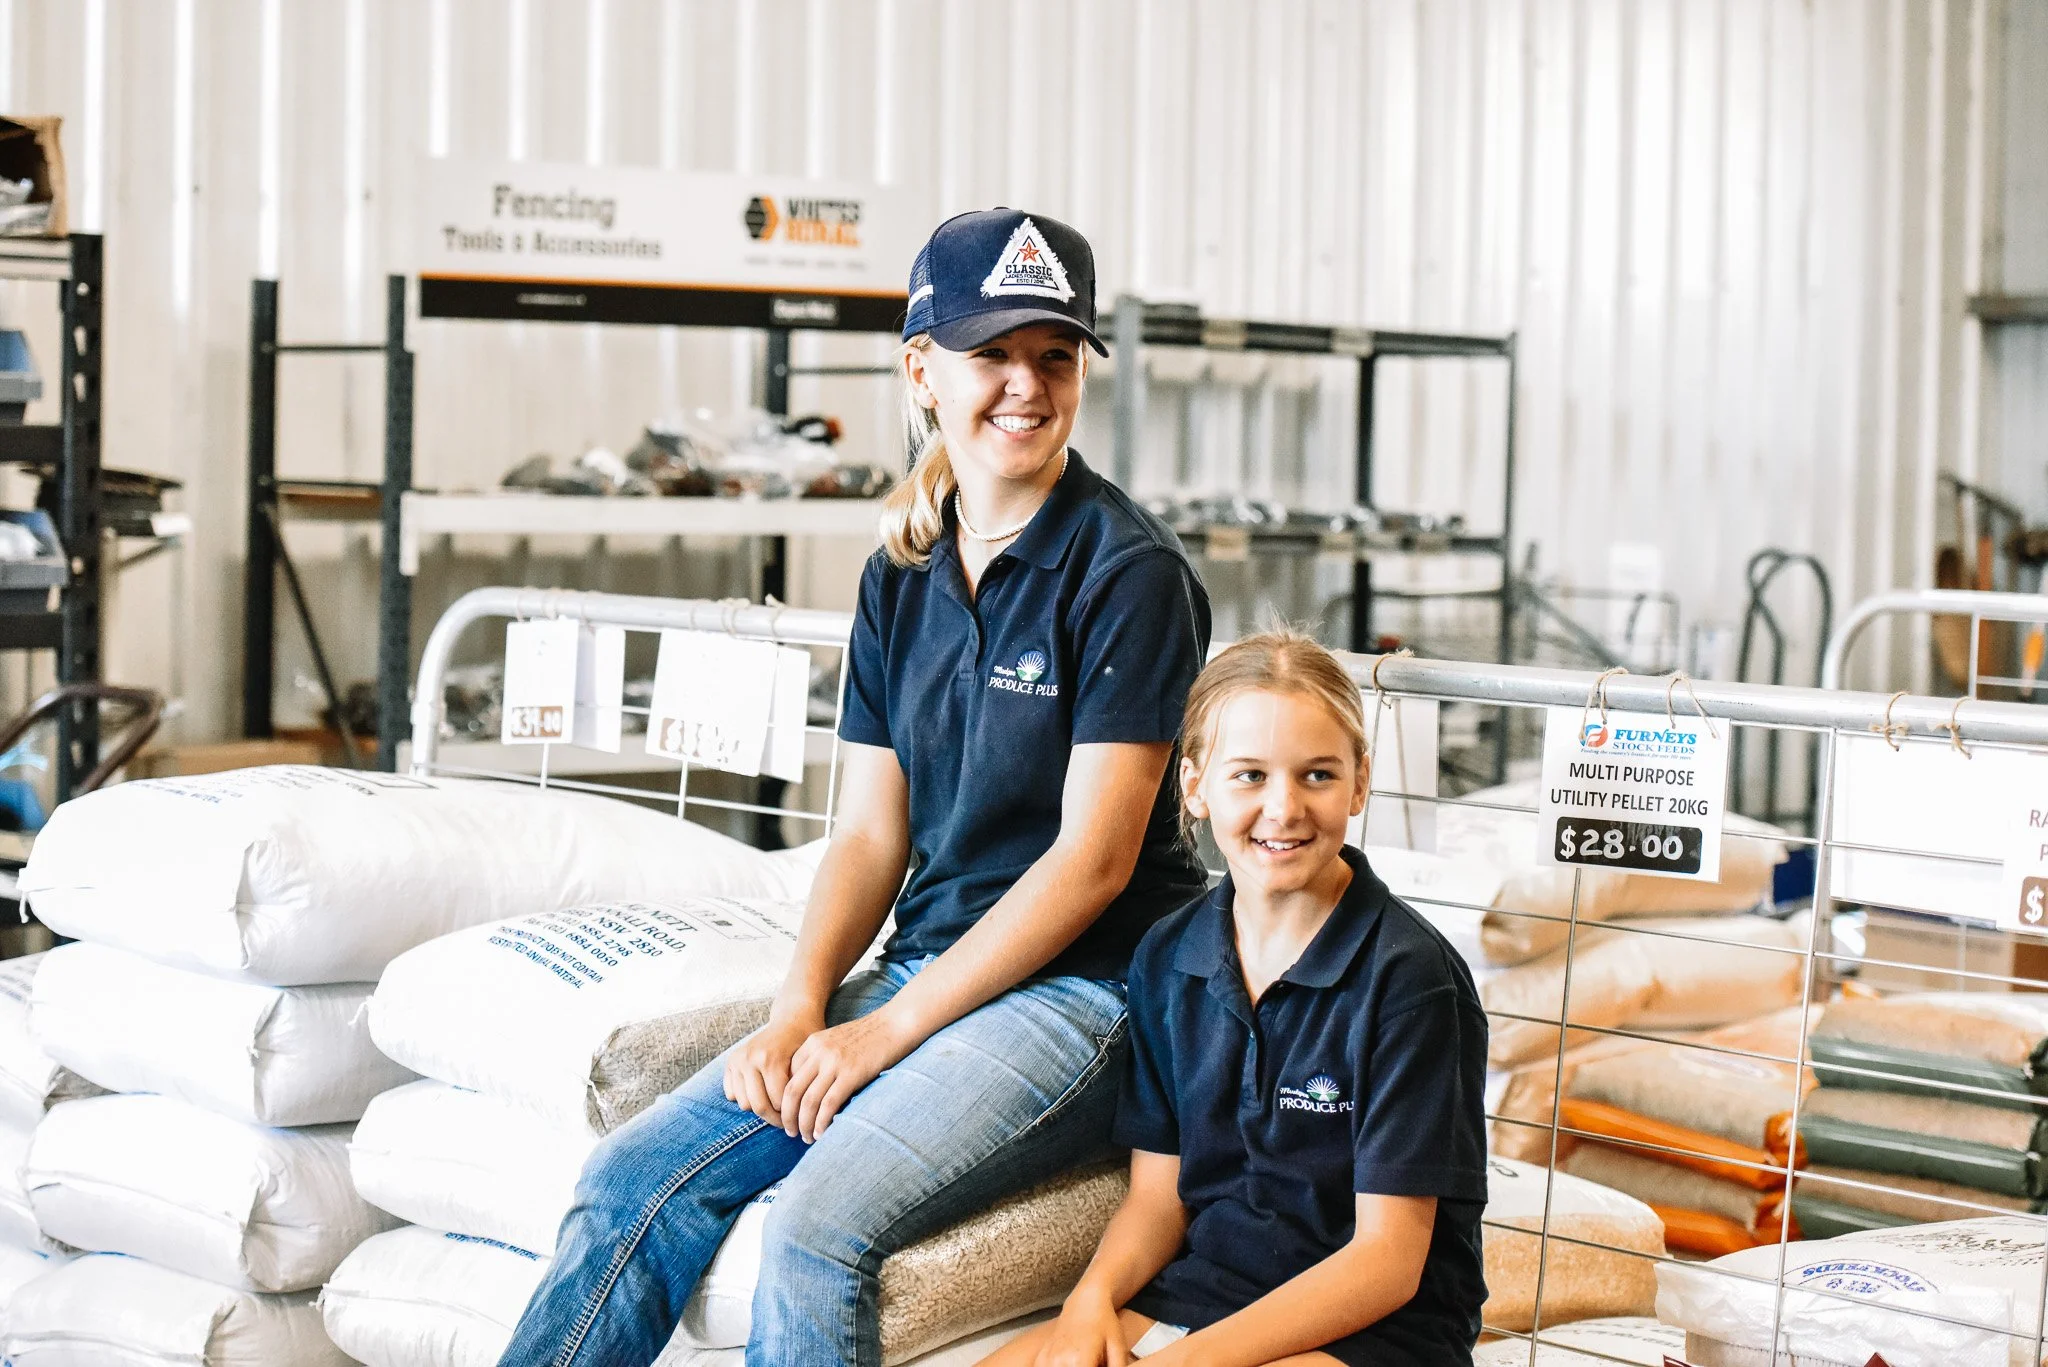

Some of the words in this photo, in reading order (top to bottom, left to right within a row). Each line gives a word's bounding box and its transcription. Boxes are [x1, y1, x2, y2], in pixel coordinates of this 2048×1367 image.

[492, 183, 616, 231] Fencing
[444, 222, 503, 252] Tools
[532, 229, 661, 258] Accessories
[1005, 264, 1052, 276] CLASSIC
[988, 676, 1034, 694] PRODUCE
[1035, 684, 1059, 697] PLUS
[1611, 742, 1654, 753] STOCK
[1657, 744, 1696, 755] FEEDS
[1613, 728, 1697, 745] FURNEYS
[1569, 763, 1619, 781] MULTI
[1623, 766, 1695, 786] PURPOSE
[1550, 788, 1608, 808] UTILITY
[1611, 793, 1664, 812] PELLET
[1668, 797, 1709, 816] 20KG
[565, 932, 593, 950] 6884
[590, 947, 619, 968] 0050
[597, 916, 632, 935] NSW
[628, 936, 664, 958] 2830
[603, 938, 634, 958] 2798
[642, 925, 687, 954] ROAD,
[526, 949, 553, 969] ANIMAL
[549, 963, 585, 989] MATERIAL
[559, 951, 578, 964] NOT
[572, 960, 606, 985] CONTAIN
[1279, 1097, 1337, 1114] PRODUCE
